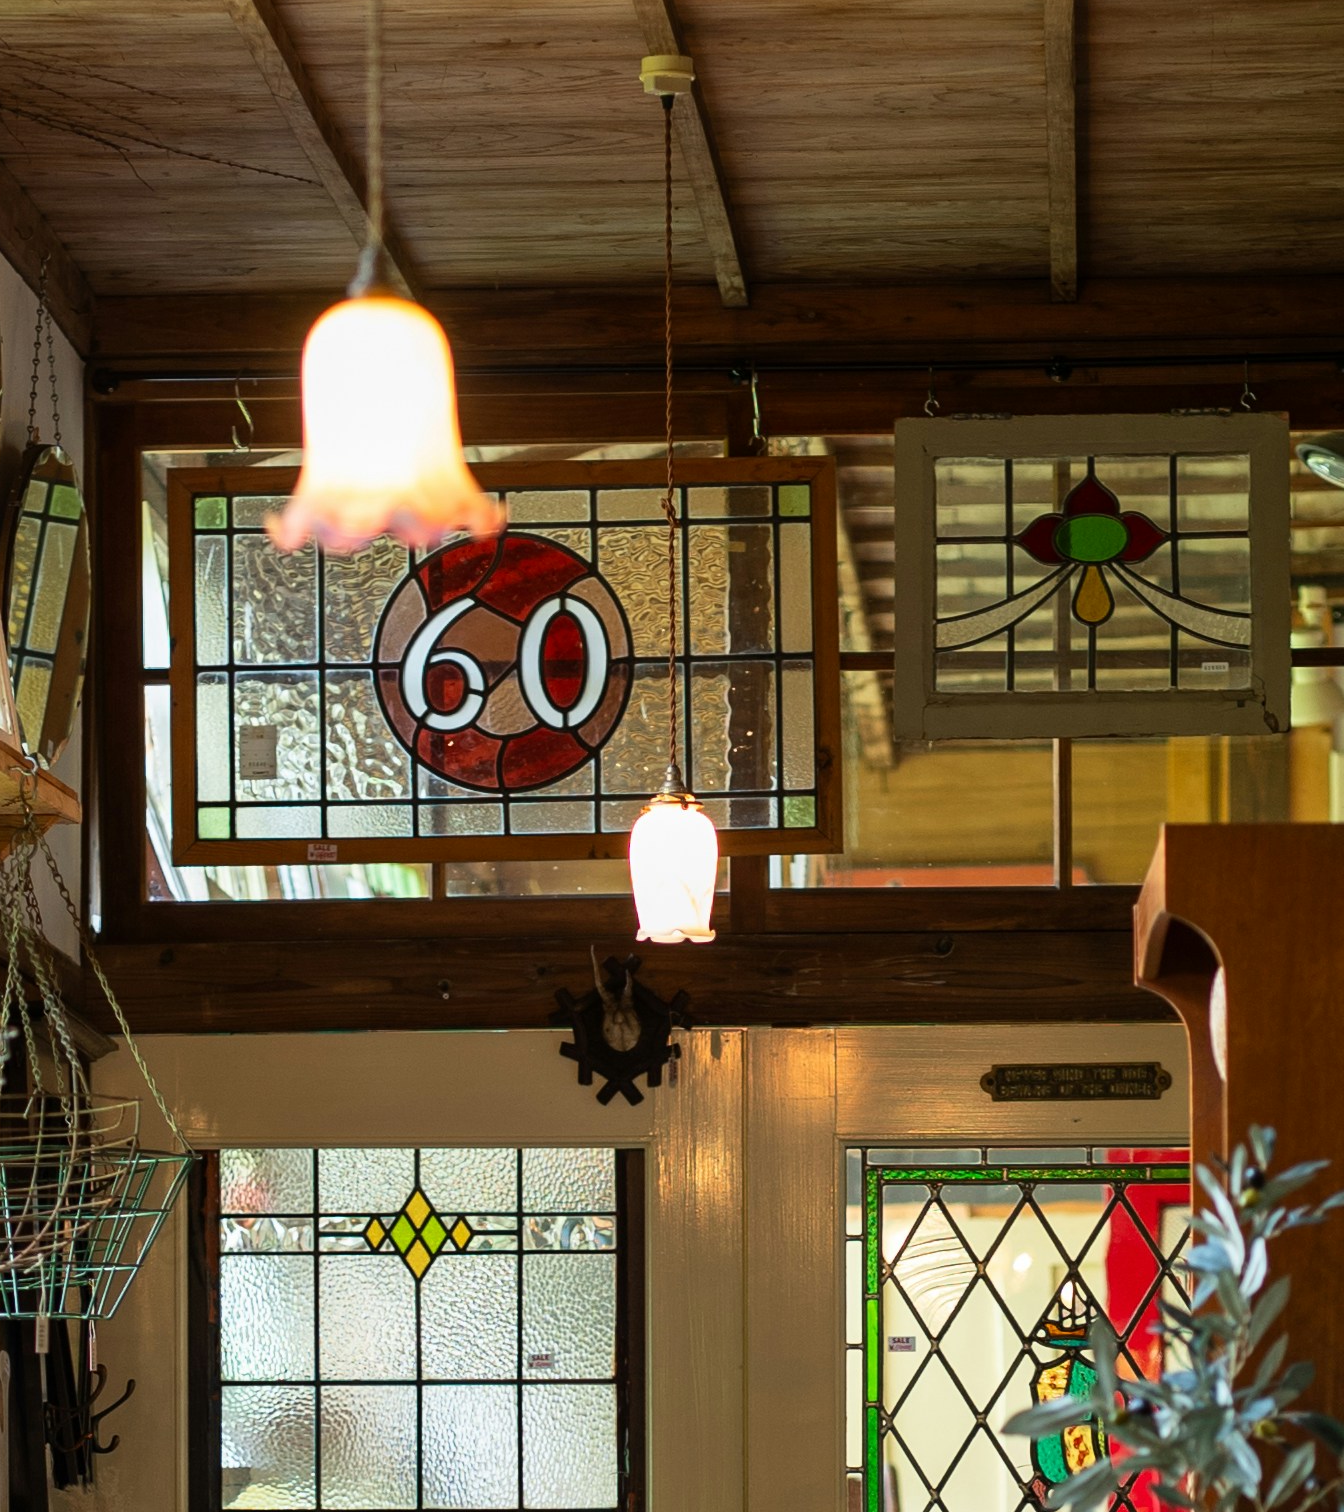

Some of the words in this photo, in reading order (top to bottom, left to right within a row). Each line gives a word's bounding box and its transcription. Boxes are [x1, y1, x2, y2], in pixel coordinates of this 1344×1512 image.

[402, 597, 607, 730] 60
[1093, 1068, 1116, 1080] THE
[1000, 1084, 1053, 1097] BEWARE
[1058, 1084, 1074, 1096] OF
[1082, 1083, 1105, 1096] THE
[1109, 1083, 1153, 1096] OWNER
